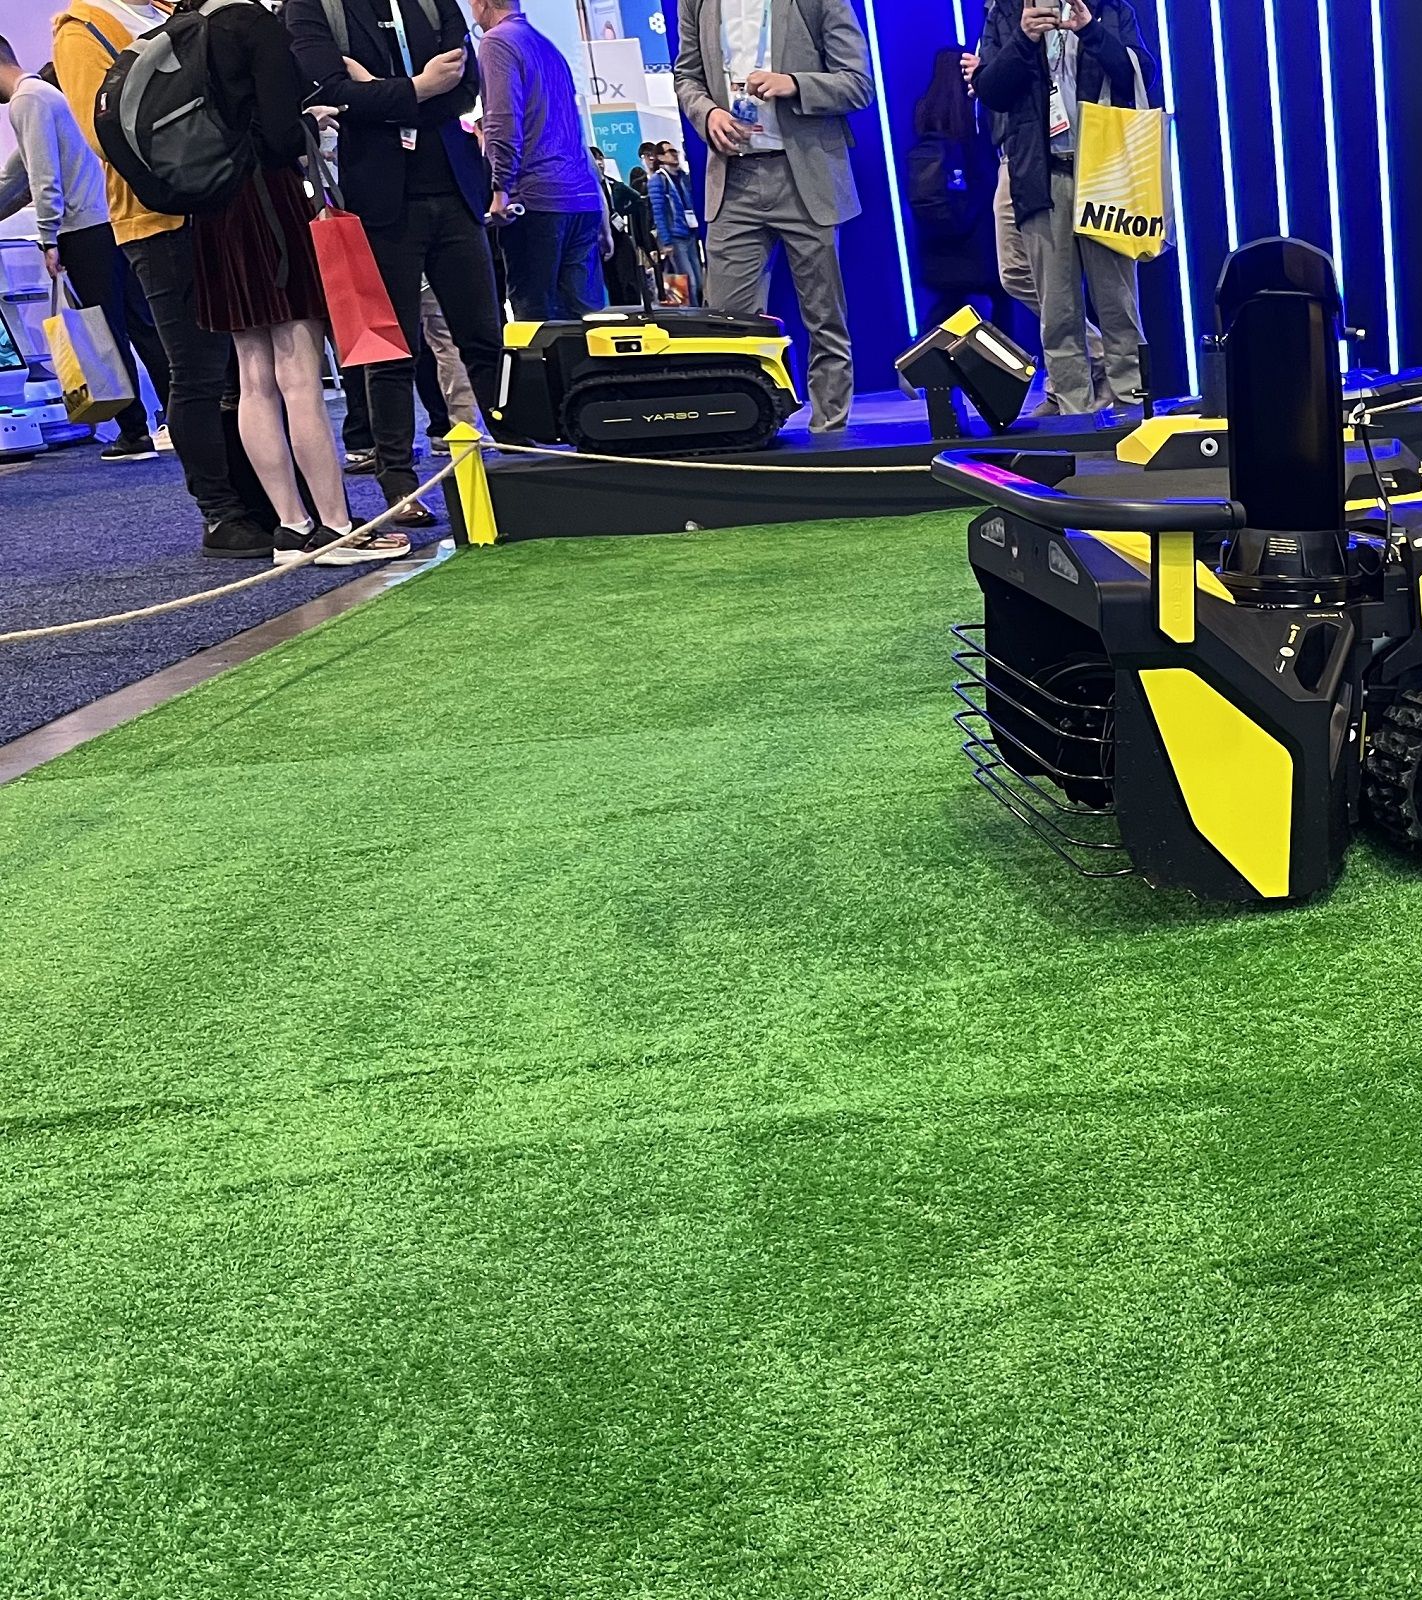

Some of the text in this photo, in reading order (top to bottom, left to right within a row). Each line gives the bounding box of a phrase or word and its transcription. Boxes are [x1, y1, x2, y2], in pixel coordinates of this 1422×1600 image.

[611, 122, 635, 135] PCR
[1080, 201, 1164, 237] Nikon
[642, 411, 700, 422] YARBO
